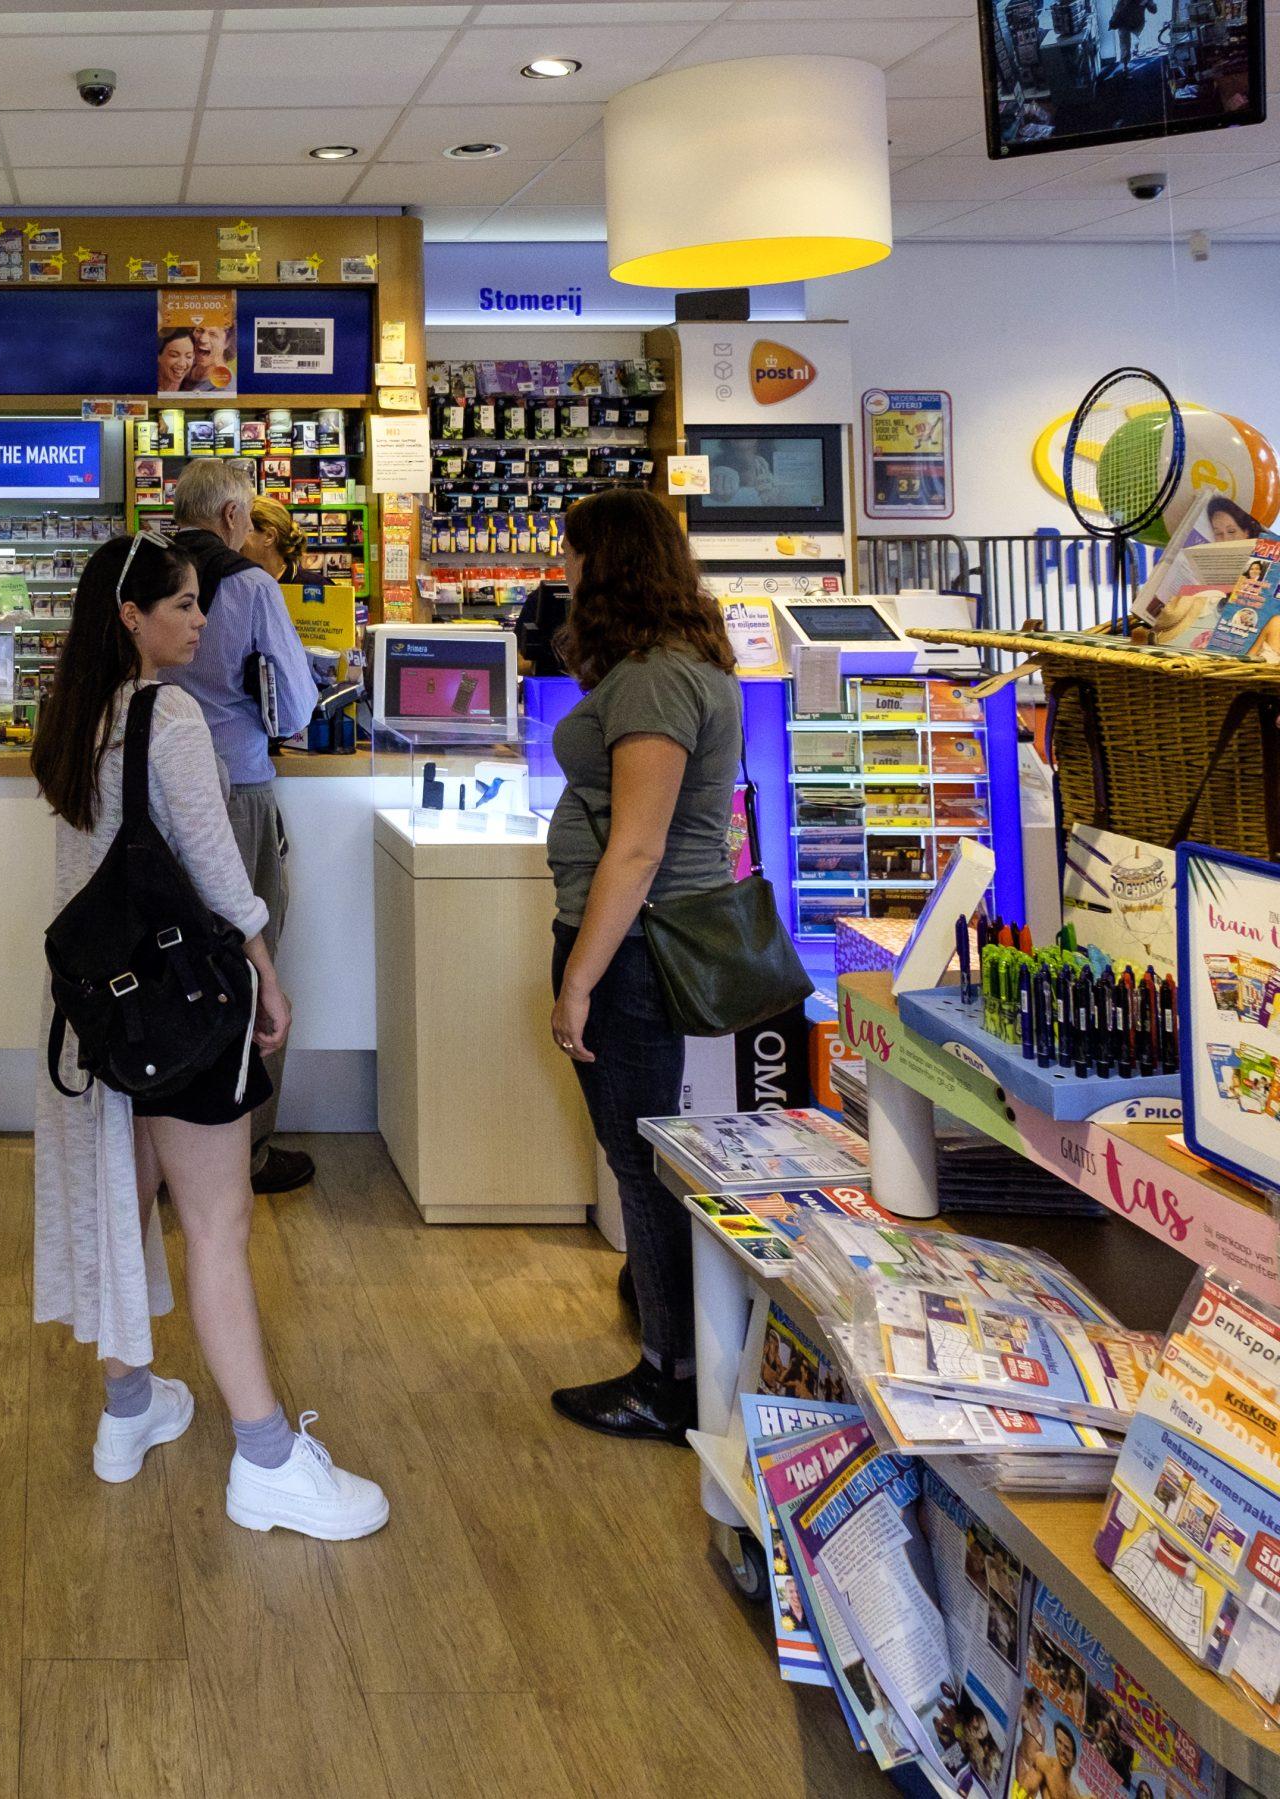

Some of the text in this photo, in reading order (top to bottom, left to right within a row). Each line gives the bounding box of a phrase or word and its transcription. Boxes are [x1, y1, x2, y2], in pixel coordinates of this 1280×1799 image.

[479, 287, 582, 317] Stomerij
[755, 365, 810, 383] postnl
[25, 445, 86, 465] MARKET
[844, 991, 895, 1063] tas
[1144, 1107, 1182, 1119] PILO
[1060, 1136, 1097, 1176] GRATIS
[1101, 1138, 1195, 1242] tas
[1215, 1229, 1252, 1258] aankoop
[1255, 1250, 1274, 1266] van
[1192, 1294, 1280, 1367] Denkspor
[1169, 1399, 1203, 1436] Primera
[1224, 1390, 1279, 1433] KrisKras
[1209, 1473, 1280, 1536] zomerpakke
